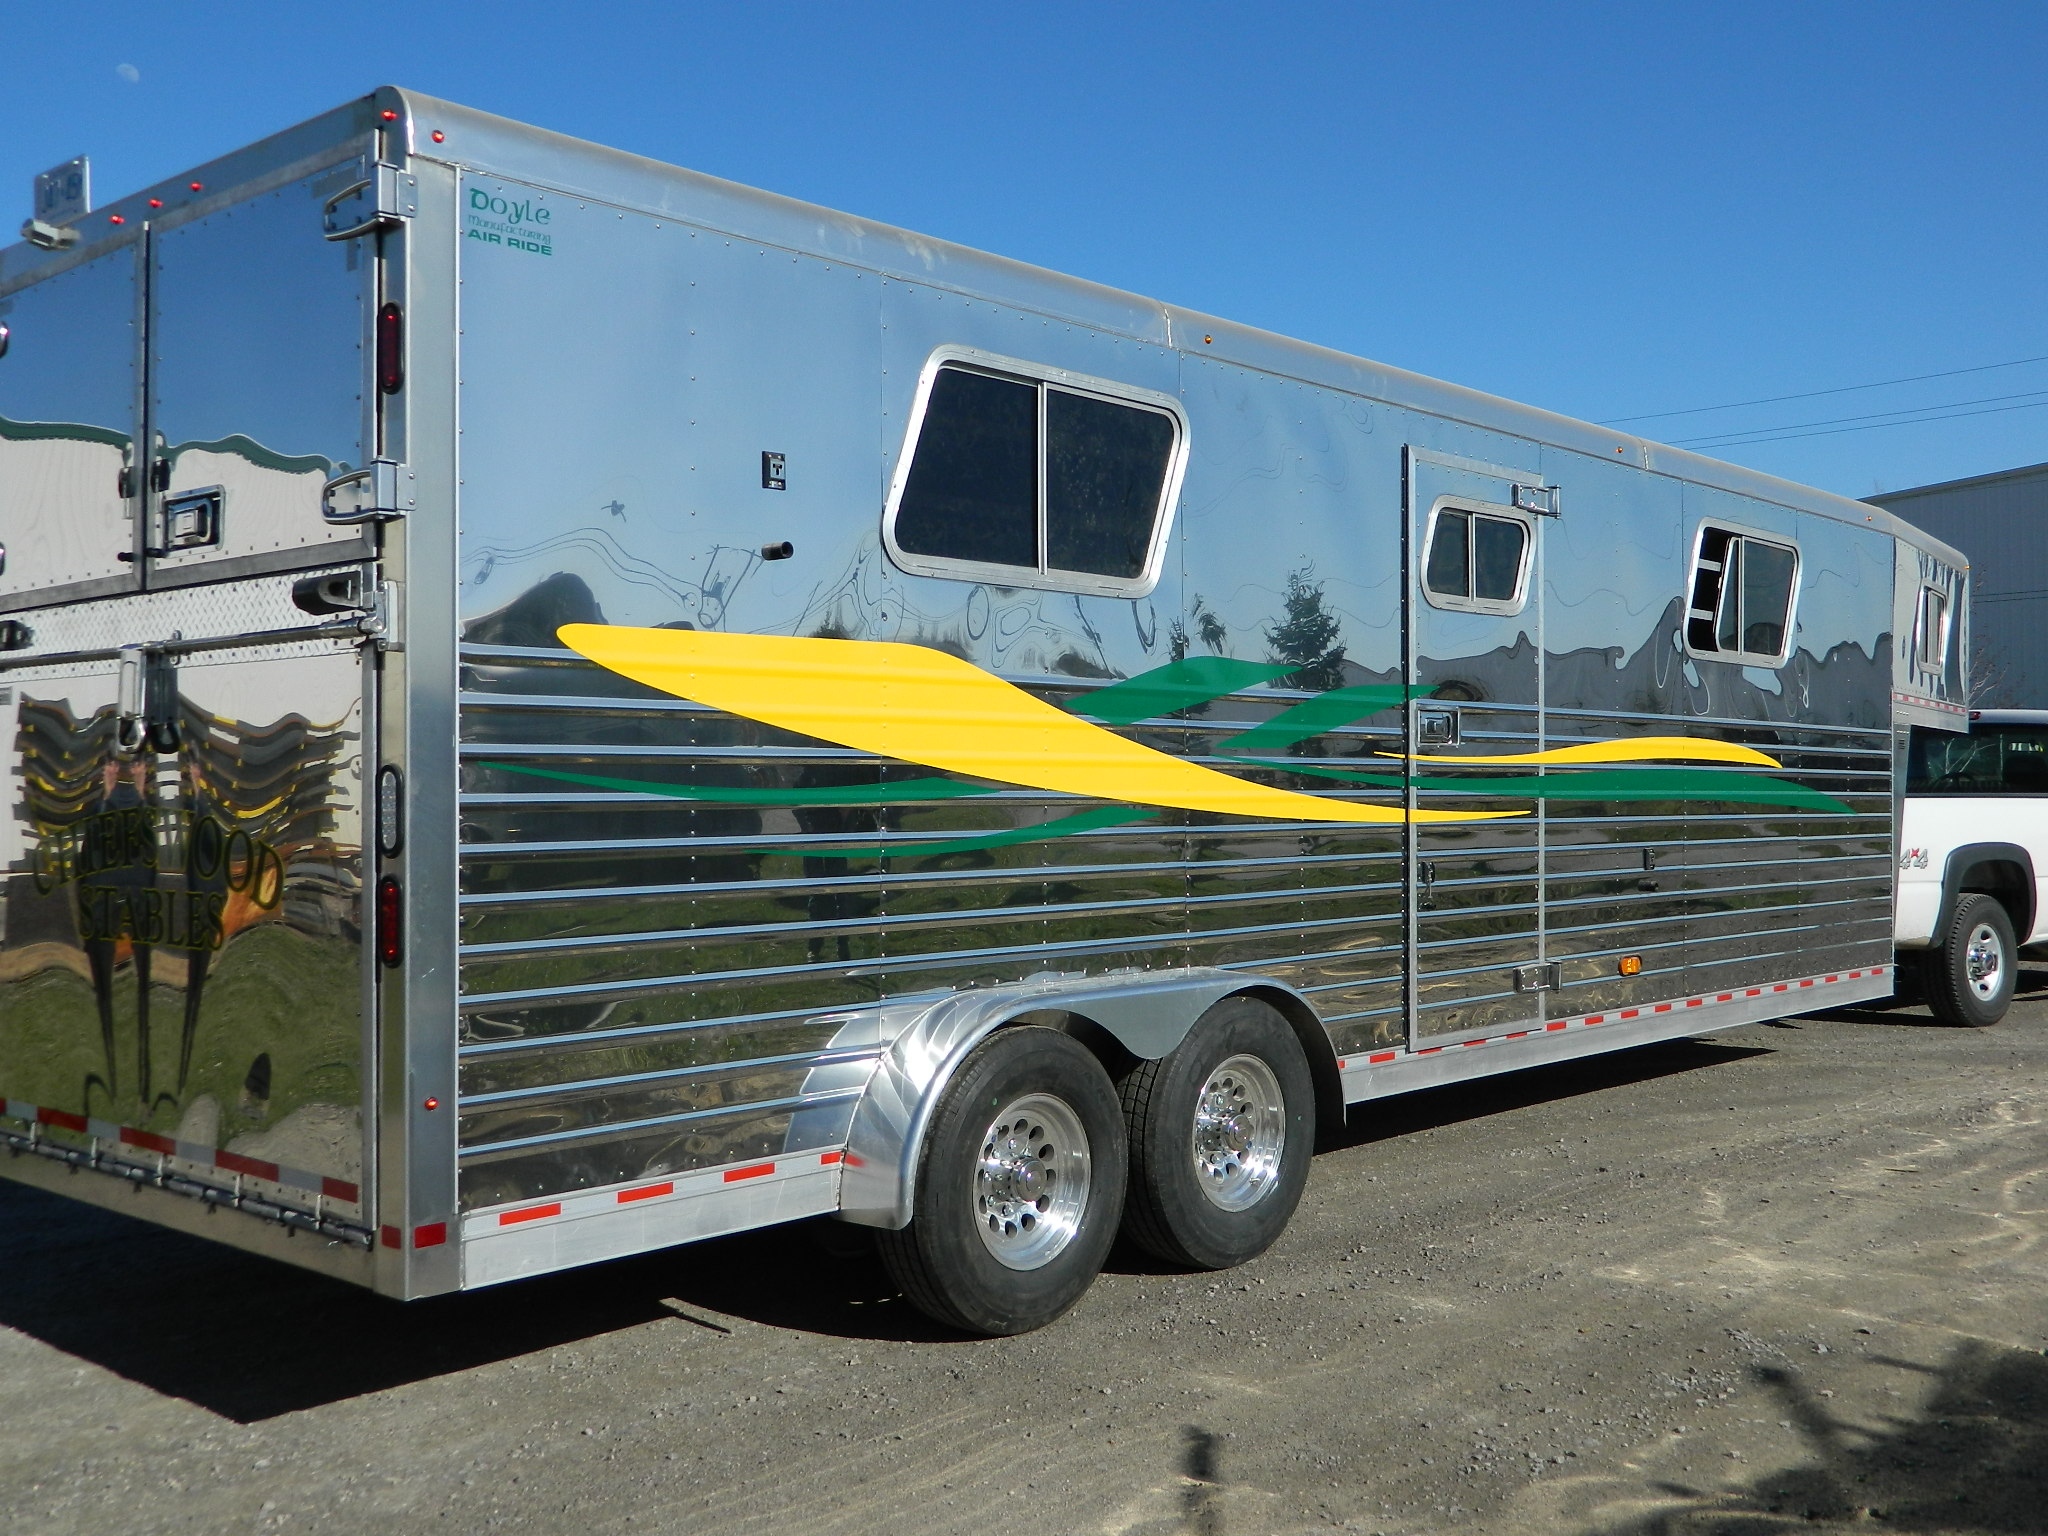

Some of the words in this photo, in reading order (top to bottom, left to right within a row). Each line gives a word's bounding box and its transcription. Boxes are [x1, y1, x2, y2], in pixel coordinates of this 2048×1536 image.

[469, 187, 552, 225] Doyle
[467, 214, 552, 244] Manufacturing
[468, 229, 501, 244] AIR
[507, 237, 552, 256] RIDE
[79, 886, 224, 950] STABLES
